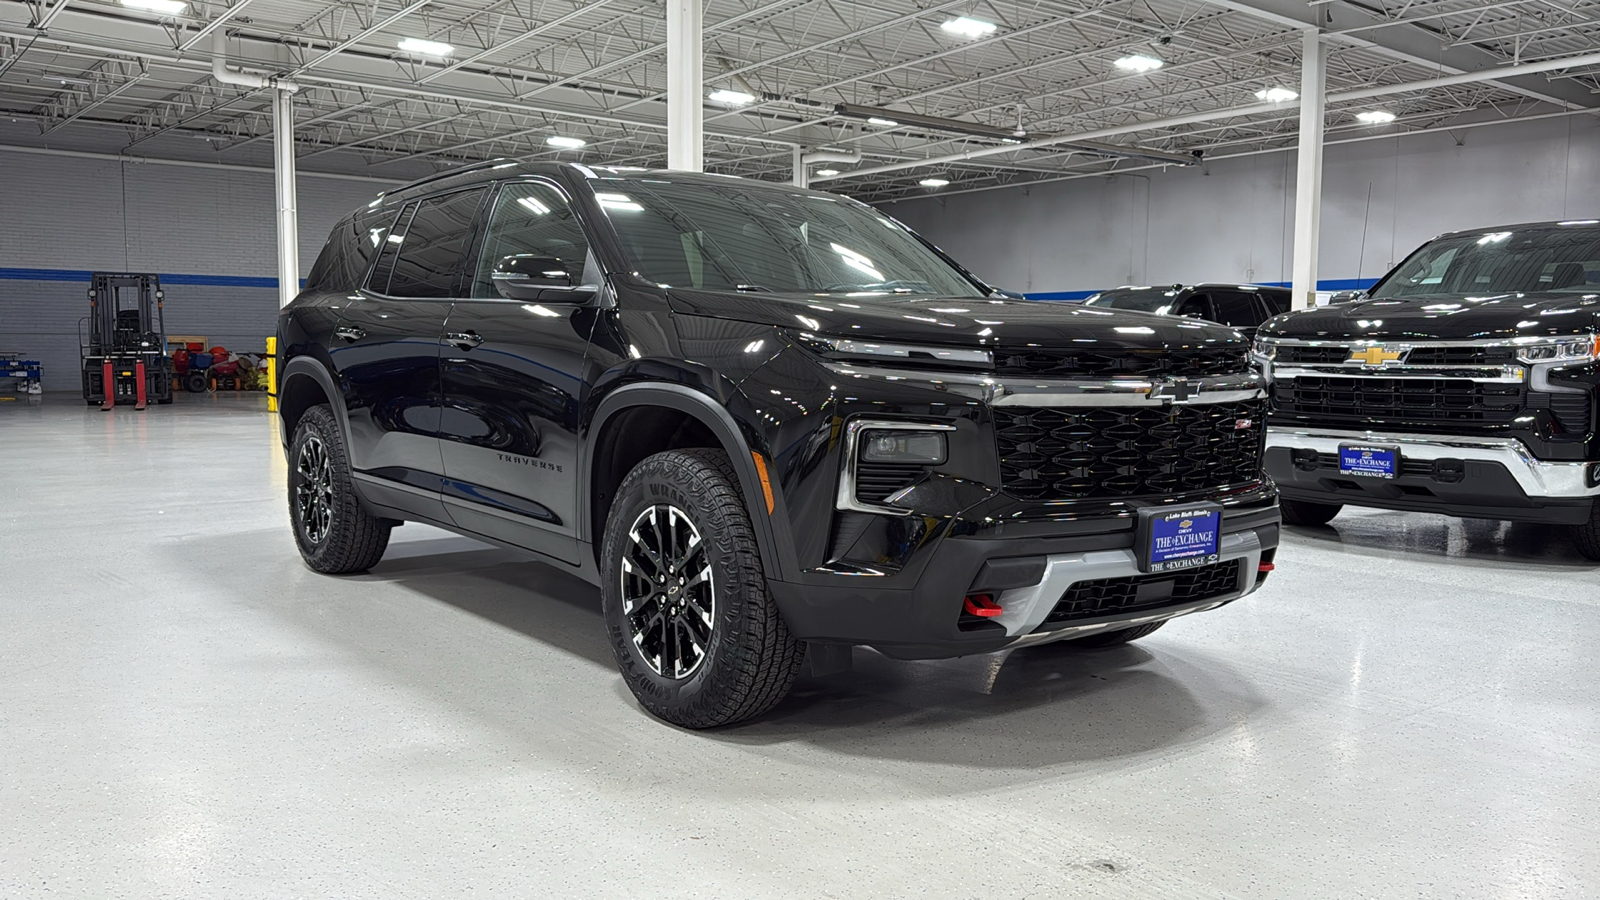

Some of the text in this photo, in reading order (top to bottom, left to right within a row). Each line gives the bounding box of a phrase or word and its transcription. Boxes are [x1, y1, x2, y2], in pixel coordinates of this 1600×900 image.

[497, 453, 562, 472] TRAVERSE
[1359, 458, 1391, 467] EXCHANGE
[1156, 531, 1214, 548] THE EXCHANGE
[1151, 557, 1205, 572] THE EXCHANGE
